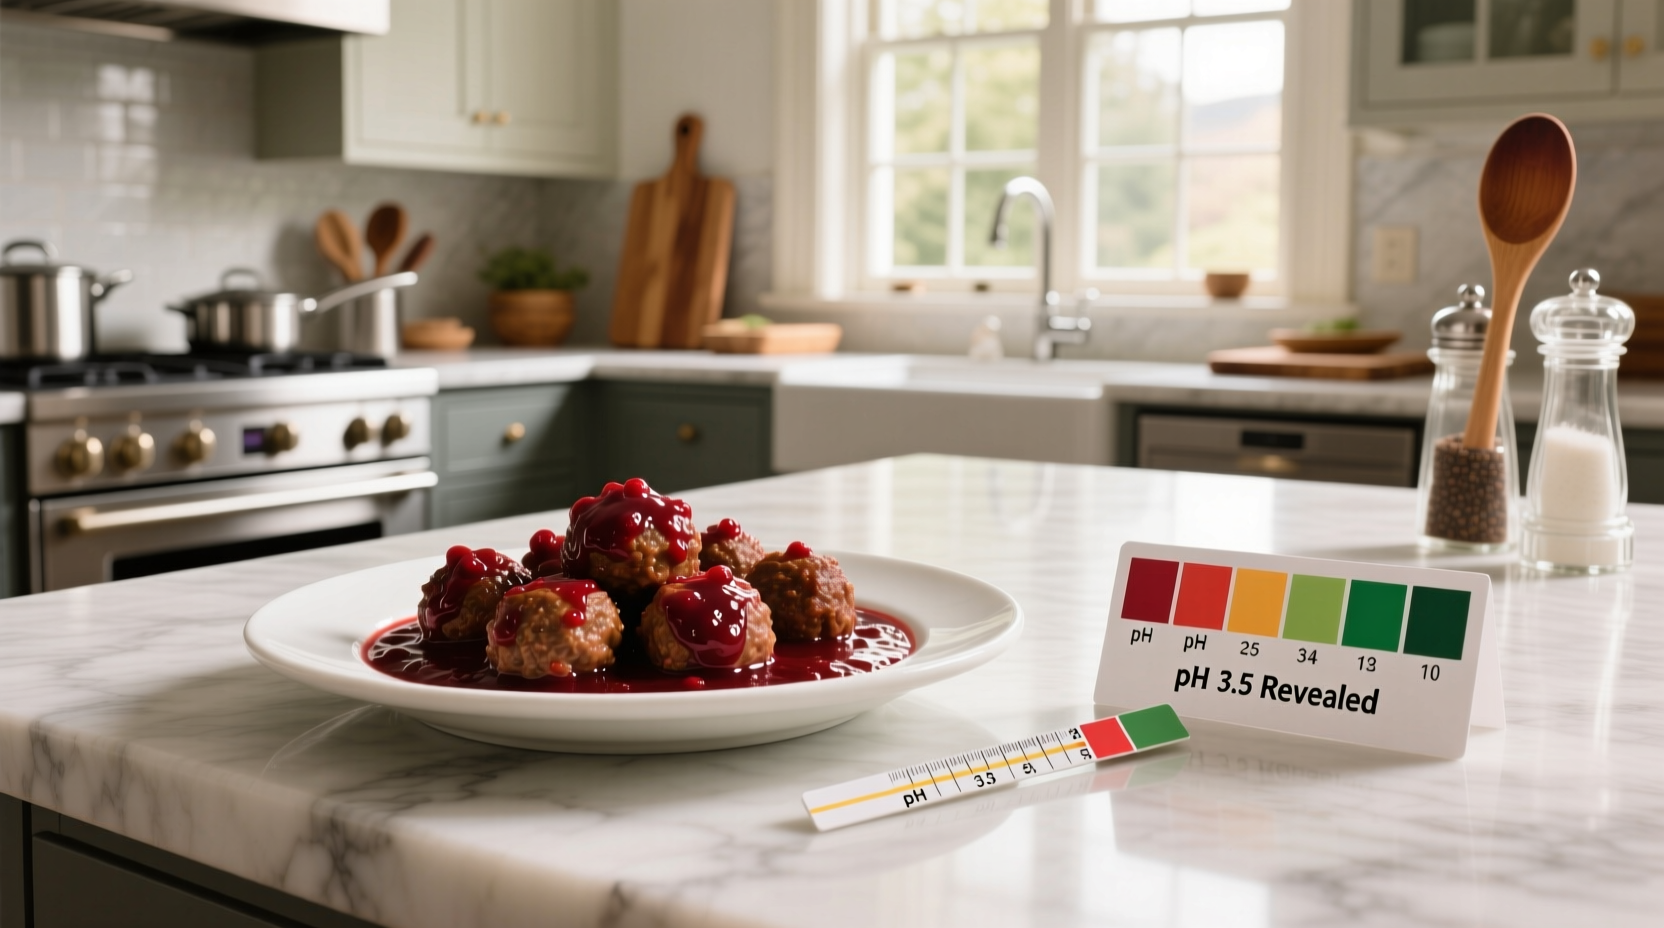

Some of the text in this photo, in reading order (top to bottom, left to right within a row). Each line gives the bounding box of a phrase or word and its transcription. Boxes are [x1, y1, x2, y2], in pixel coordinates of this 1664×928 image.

[1130, 626, 1154, 645] pH
[1183, 634, 1208, 653] pH
[1239, 640, 1260, 657] 25
[1296, 647, 1318, 665] 34
[1421, 663, 1441, 682] 10
[1174, 665, 1380, 715] pH 3.5 Revealed
[903, 788, 928, 808] pH
